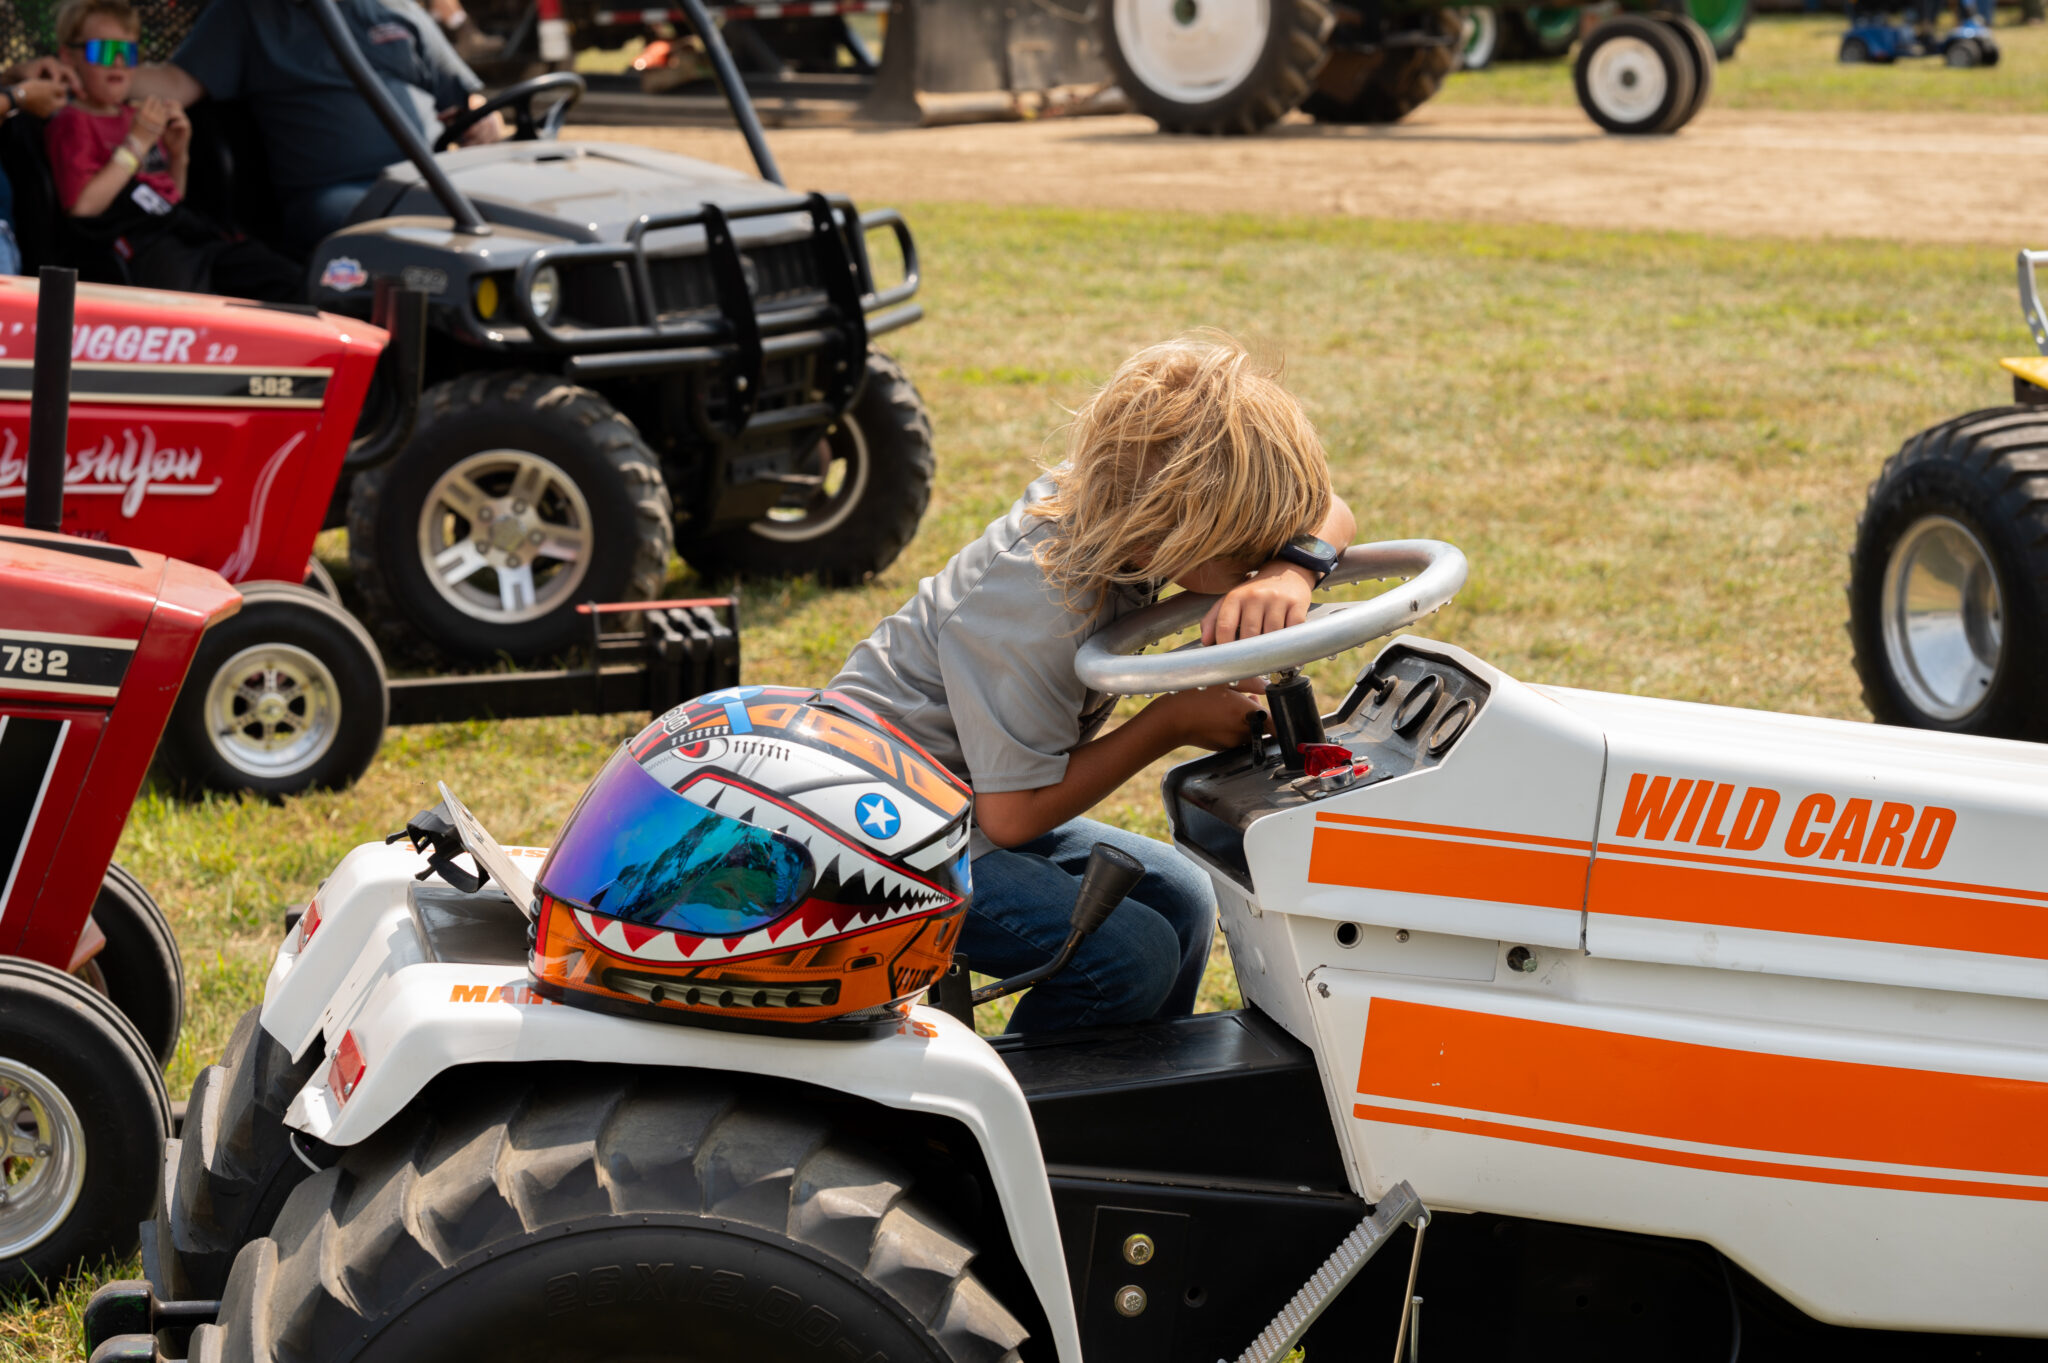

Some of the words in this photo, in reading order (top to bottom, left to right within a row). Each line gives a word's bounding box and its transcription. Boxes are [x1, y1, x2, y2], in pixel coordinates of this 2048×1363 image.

[204, 342, 239, 364] 2.0
[248, 376, 294, 397] 582
[2, 644, 69, 677] 782
[1615, 773, 1781, 851] WILD
[1784, 793, 1957, 870] CARD
